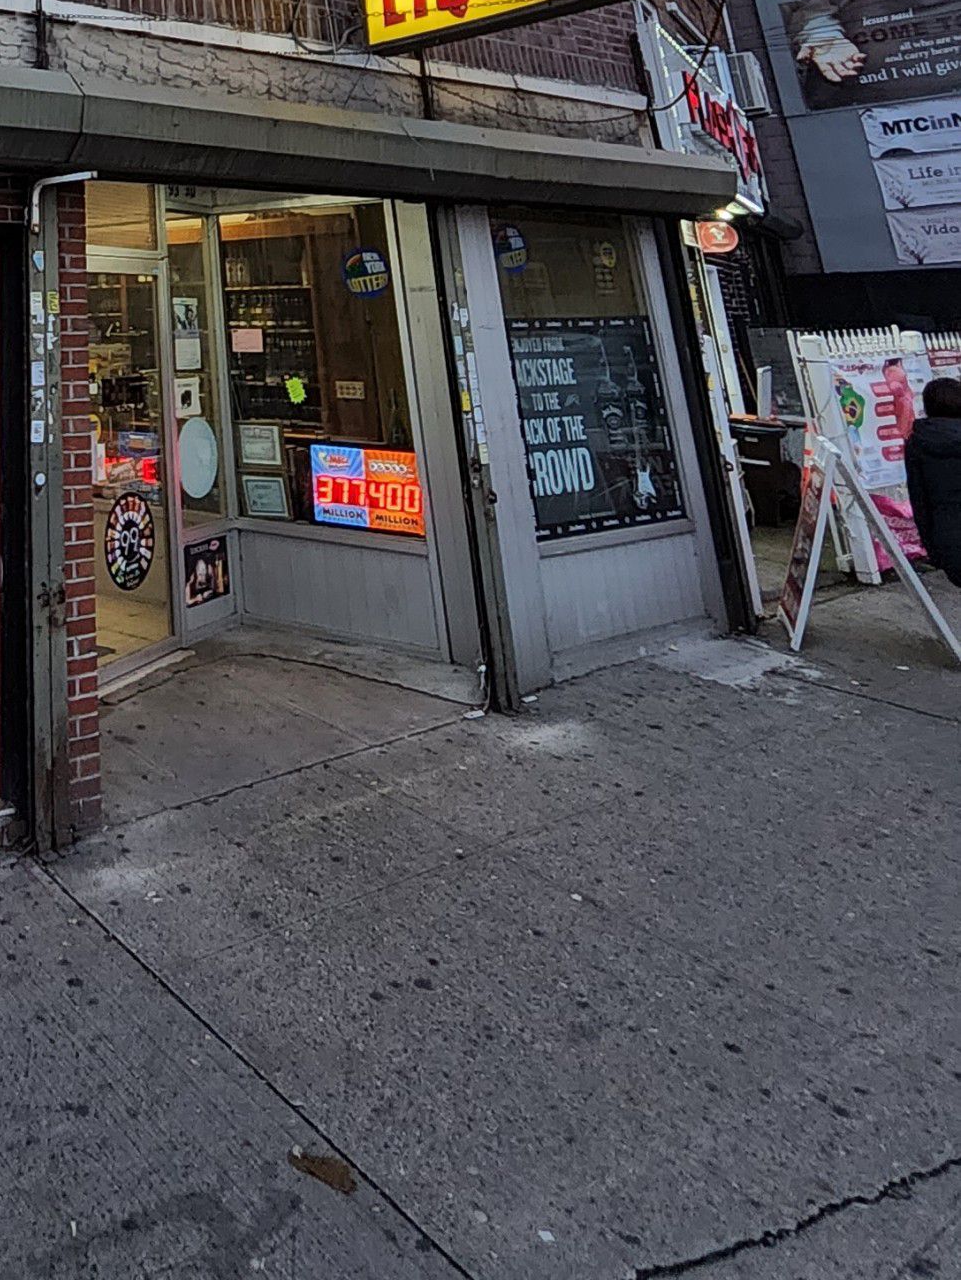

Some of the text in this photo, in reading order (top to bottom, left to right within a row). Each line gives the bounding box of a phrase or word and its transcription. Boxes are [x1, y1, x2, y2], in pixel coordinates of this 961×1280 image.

[885, 52, 903, 63] and
[859, 59, 961, 85] and I will giv
[907, 166, 943, 180] Life
[516, 358, 577, 387] ACKSTAGE
[531, 391, 562, 412] TO THE
[524, 415, 587, 445] ACK OF THE
[318, 476, 366, 506] 377
[368, 482, 421, 513] 400
[322, 507, 364, 520] MILLION
[375, 514, 418, 526] MILLION
[120, 527, 139, 556] 99
